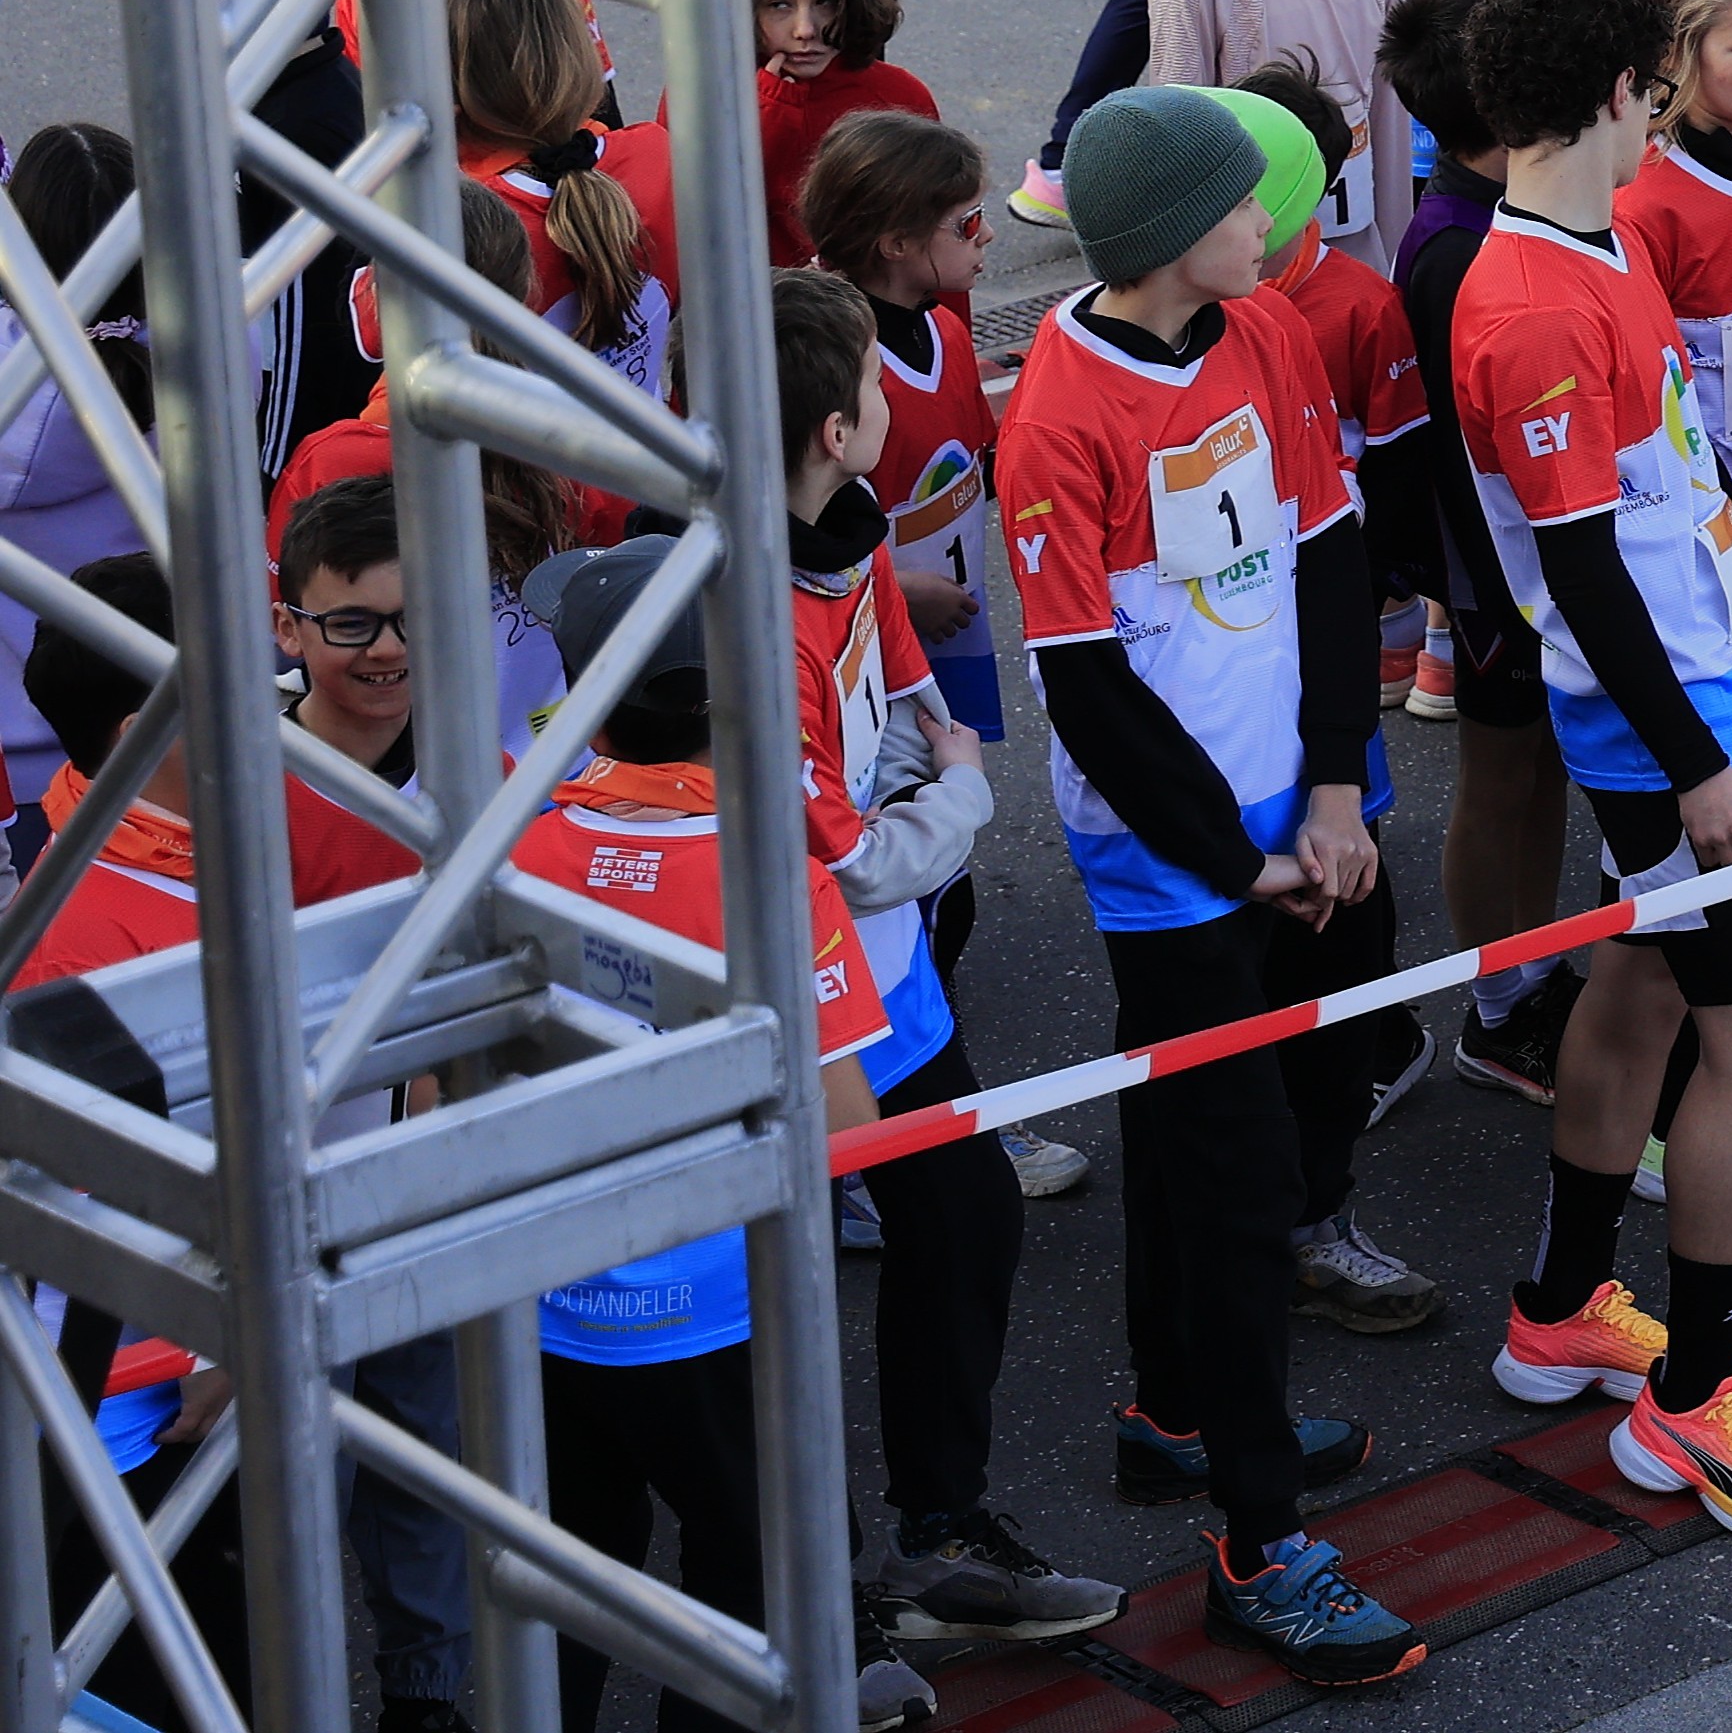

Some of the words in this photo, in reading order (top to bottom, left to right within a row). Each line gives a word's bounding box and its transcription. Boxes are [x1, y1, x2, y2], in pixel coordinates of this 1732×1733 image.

[1327, 177, 1350, 226] 1
[1209, 431, 1244, 461] lalux
[1520, 411, 1571, 459] EY
[951, 478, 978, 511] lalux
[1217, 489, 1243, 549] 1
[944, 533, 968, 586] 1
[1016, 533, 1047, 575] Y
[1215, 548, 1270, 589] POST
[1219, 574, 1274, 602] LUXEMBOURG
[1118, 621, 1172, 646] EMBOURG
[864, 674, 880, 733] 1
[588, 867, 658, 883] SPORTS
[590, 856, 660, 872] PETERS
[814, 959, 850, 1005] EY
